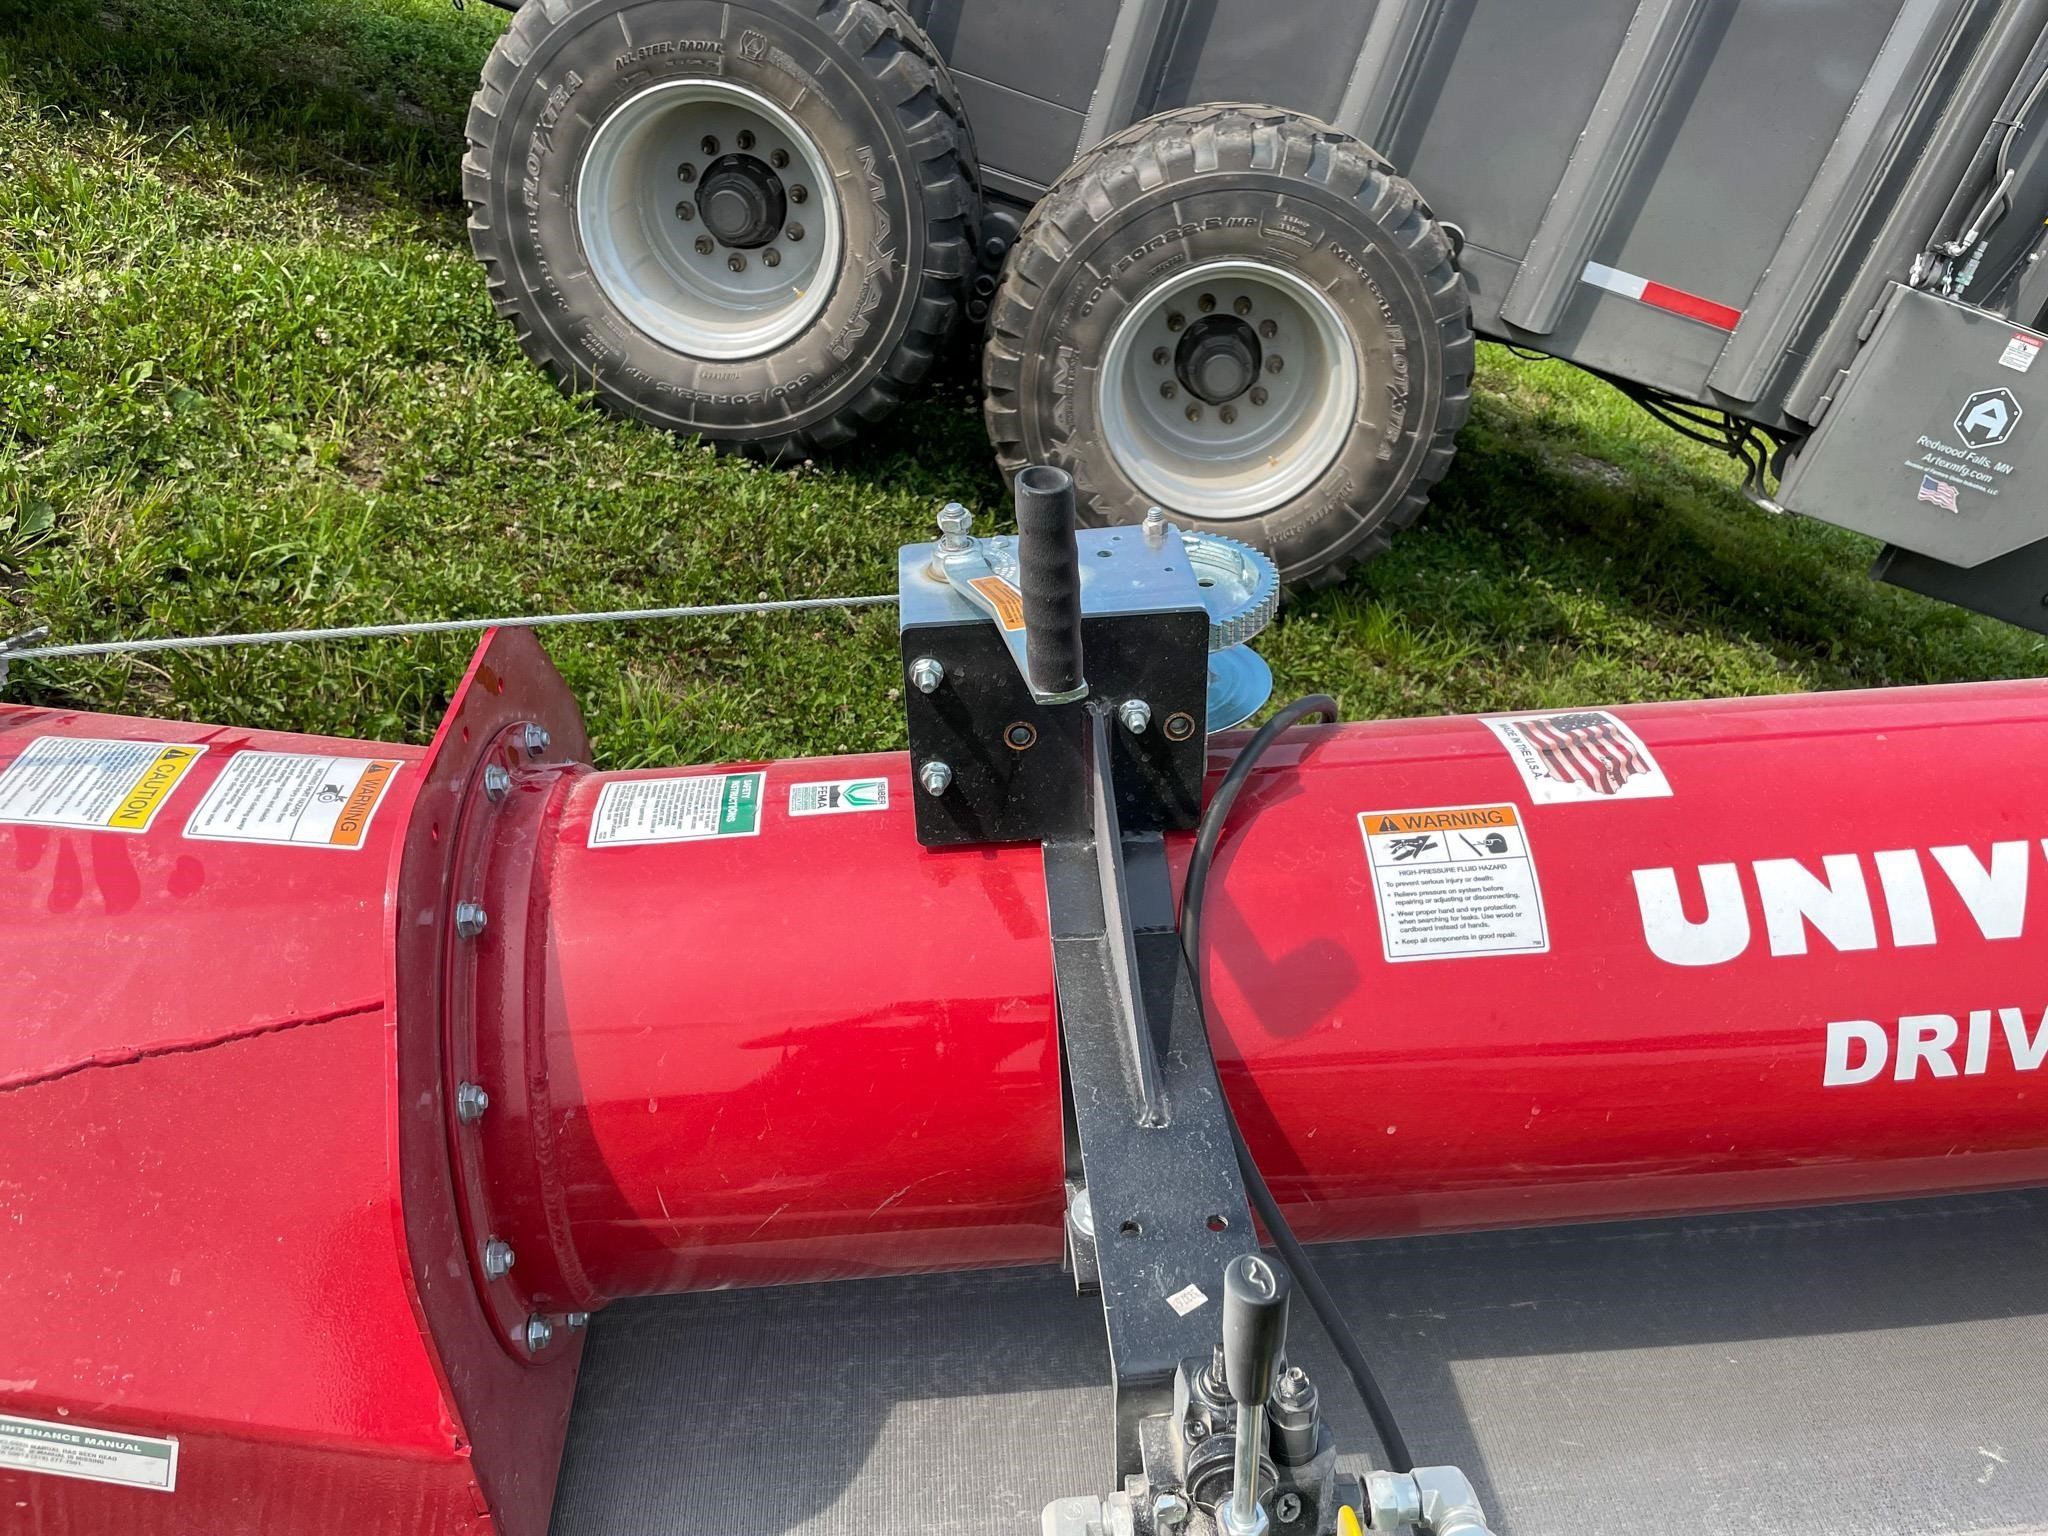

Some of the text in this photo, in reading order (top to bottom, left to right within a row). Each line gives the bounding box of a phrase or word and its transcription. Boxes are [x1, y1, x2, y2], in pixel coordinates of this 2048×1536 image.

[615, 39, 725, 71] ALL STEEL RADIAL
[829, 144, 897, 361] MAXAM
[1916, 435, 1966, 459] Redwood
[1994, 461, 2014, 474] MN
[1921, 453, 1993, 482] Artexmfg.com
[119, 763, 177, 820] CAUTION
[818, 786, 827, 809] FEMA
[340, 779, 381, 832] WARNING
[1403, 810, 1504, 829] WARNING
[1399, 867, 1456, 876] HIGH-PRESSURE
[1479, 863, 1507, 871] HAZARD
[1395, 880, 1419, 888] prevent
[1446, 877, 1463, 885] injury
[1419, 889, 1447, 897] pressure
[1395, 898, 1424, 906] repairing
[1434, 895, 1463, 904] adjusting
[1483, 903, 1516, 911] protection
[1631, 836, 2048, 967] UNIV
[1400, 925, 1433, 933] cardboard
[1417, 915, 1449, 924] searching
[1401, 938, 1419, 946] Keep
[1429, 934, 1469, 943] components
[1478, 932, 1495, 941] good
[1496, 931, 1517, 939] repair.
[1822, 1003, 2048, 1087] DRIV
[0, 1424, 142, 1452] INTENANCE MANUAL
